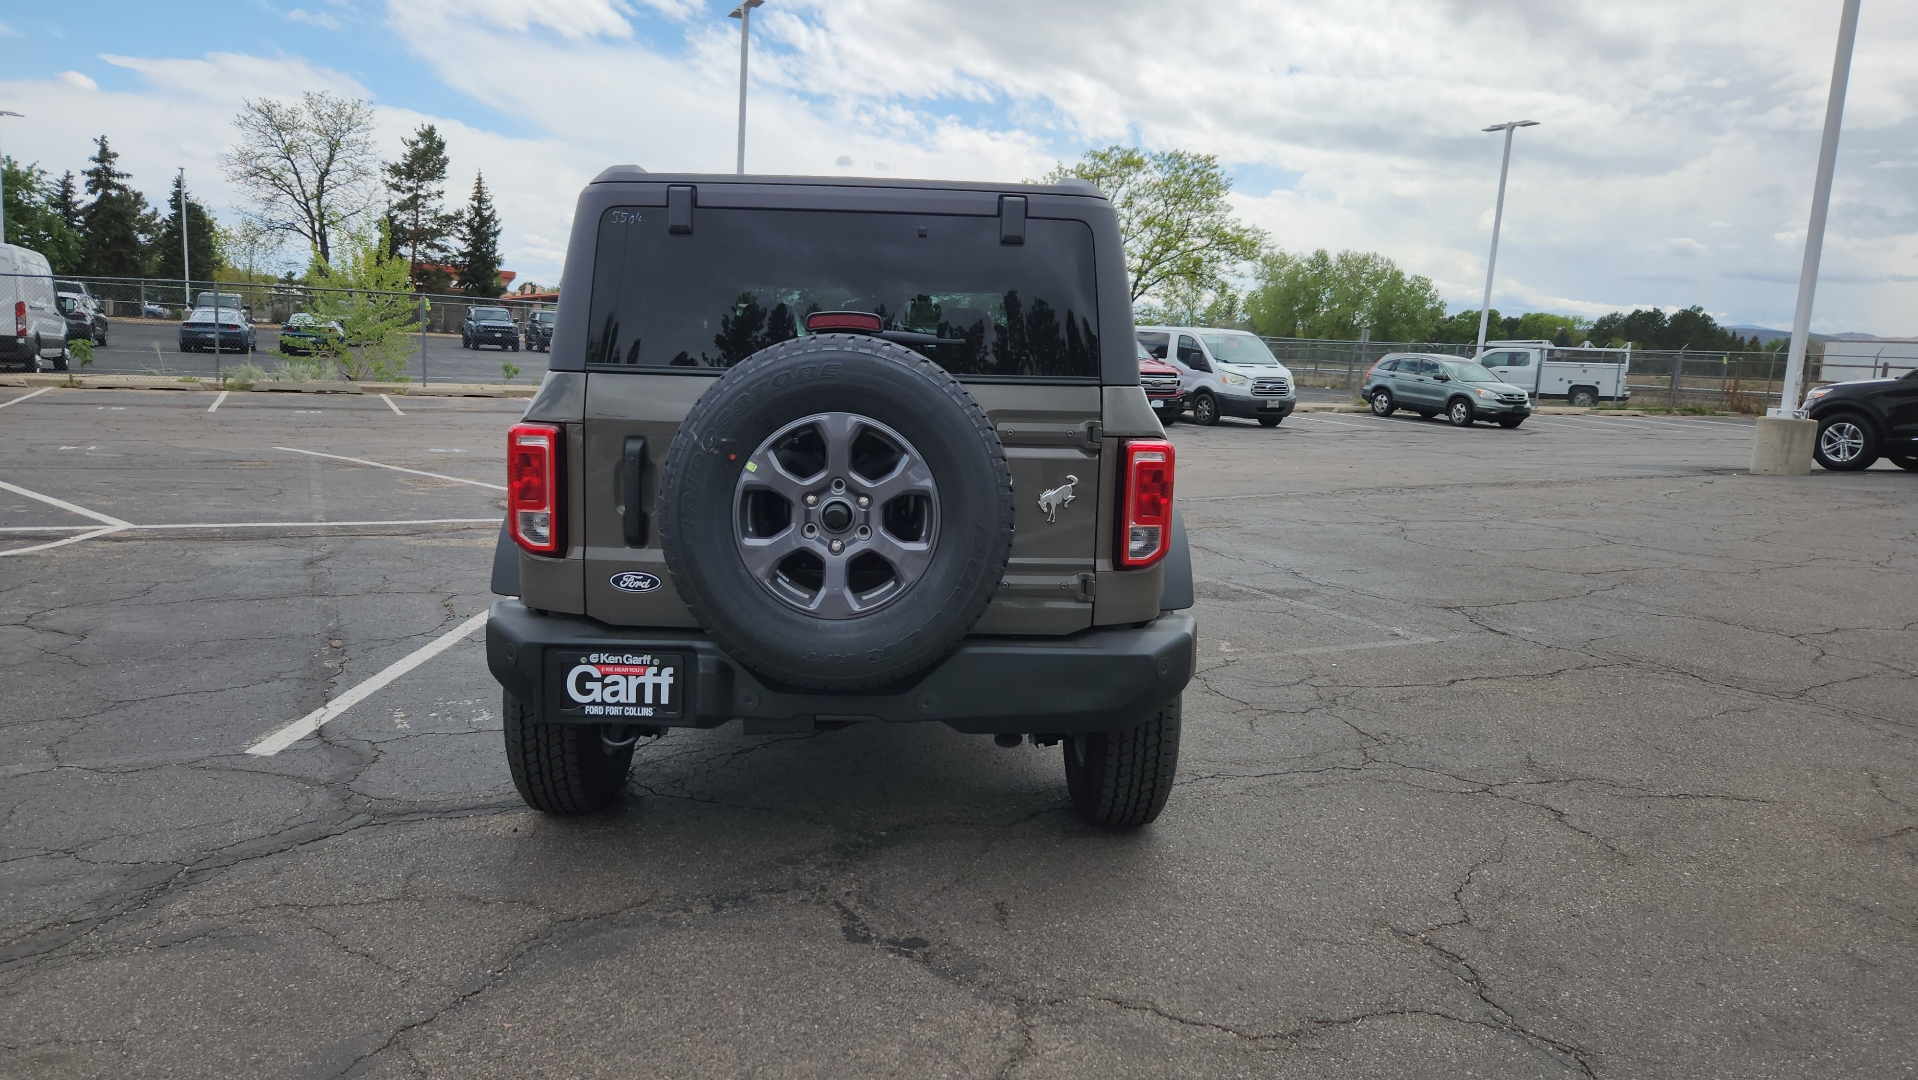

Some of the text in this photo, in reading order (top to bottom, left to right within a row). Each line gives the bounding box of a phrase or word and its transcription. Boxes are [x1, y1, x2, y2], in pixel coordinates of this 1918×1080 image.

[681, 363, 843, 546] BRIDGESTONE
[619, 574, 652, 589] Ford
[600, 653, 651, 665] Ken Garff
[566, 664, 674, 704] Garff
[585, 705, 654, 717] FORD FORT COLLINS
